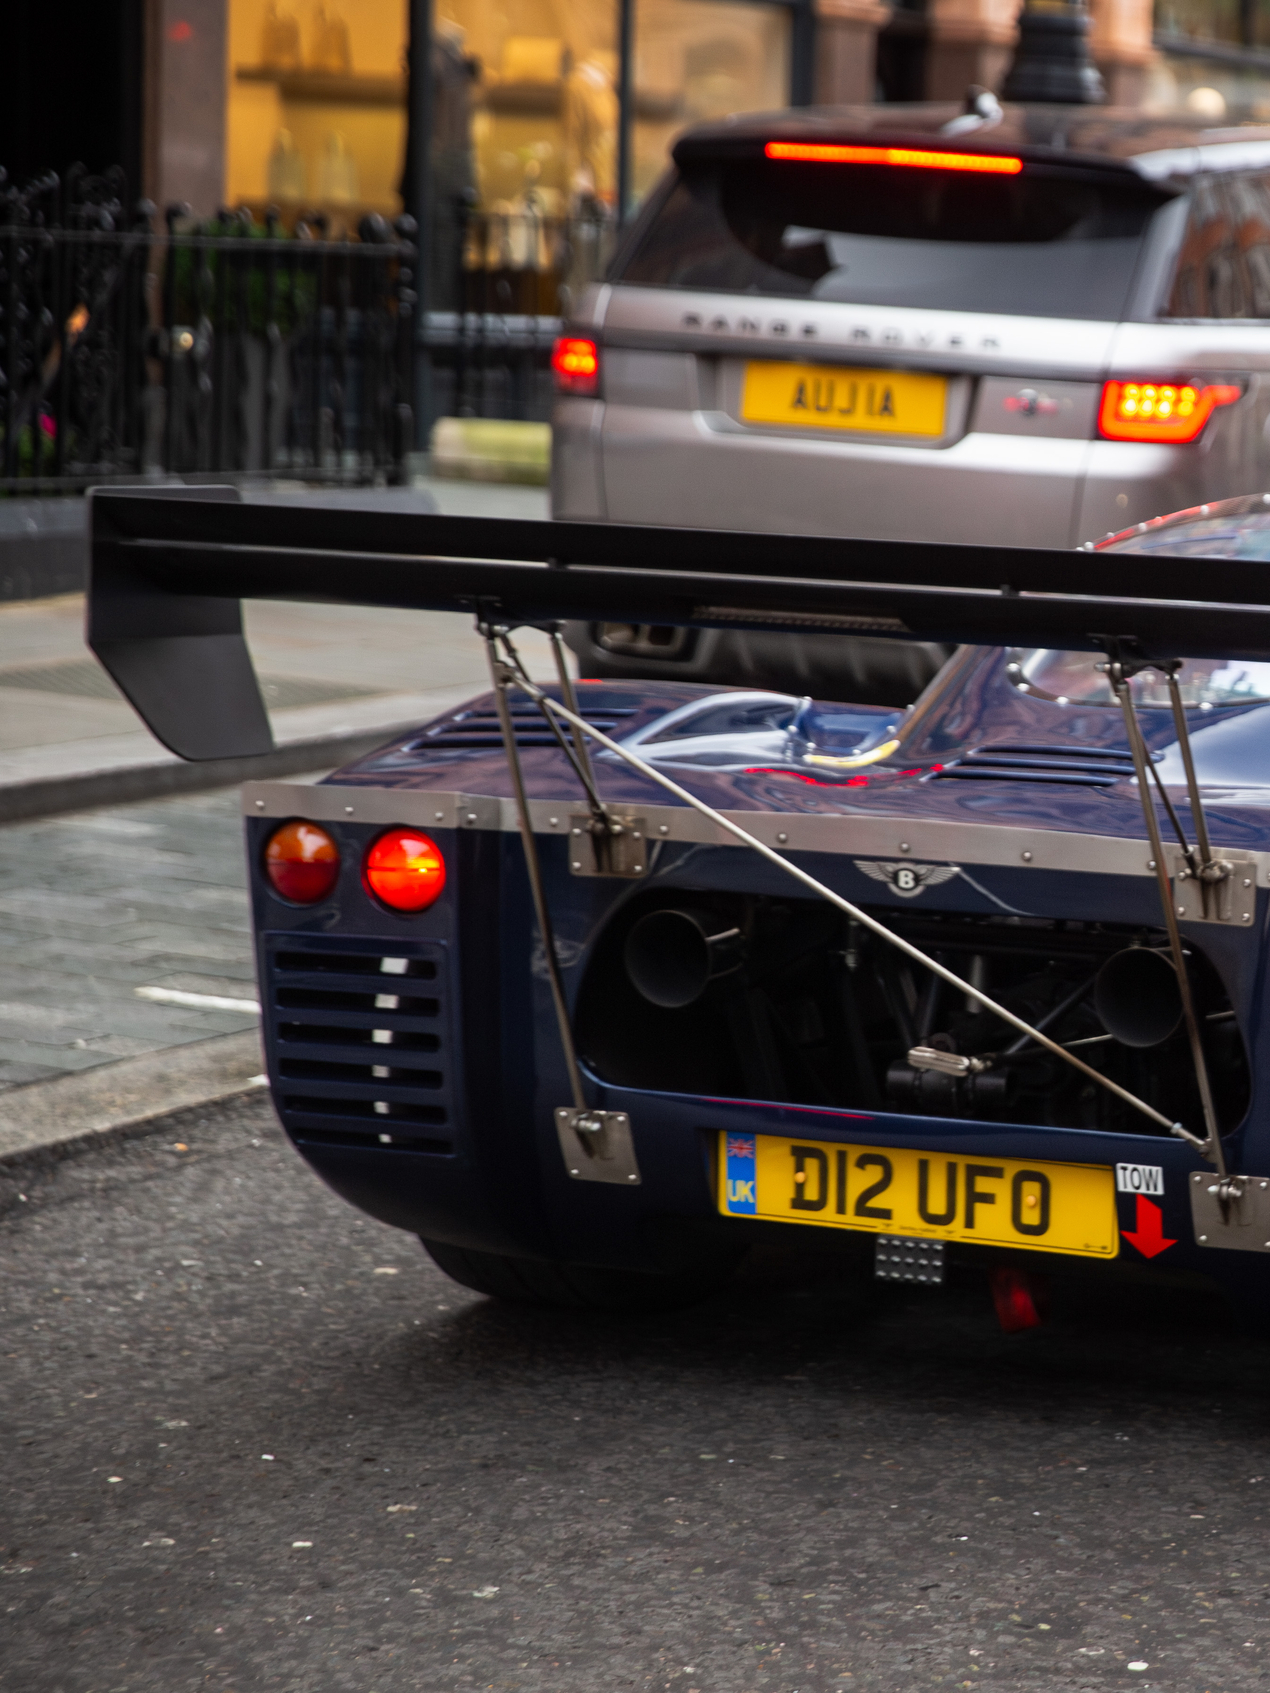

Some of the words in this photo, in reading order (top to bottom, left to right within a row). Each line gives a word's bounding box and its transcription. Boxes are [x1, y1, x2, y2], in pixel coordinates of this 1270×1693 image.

[682, 311, 818, 338] RANGE
[850, 324, 1000, 348] ROVER
[898, 869, 915, 889] B
[727, 1179, 755, 1203] UK
[790, 1144, 893, 1221] D12
[918, 1157, 1051, 1237] UFO
[1120, 1165, 1159, 1192] TOW
